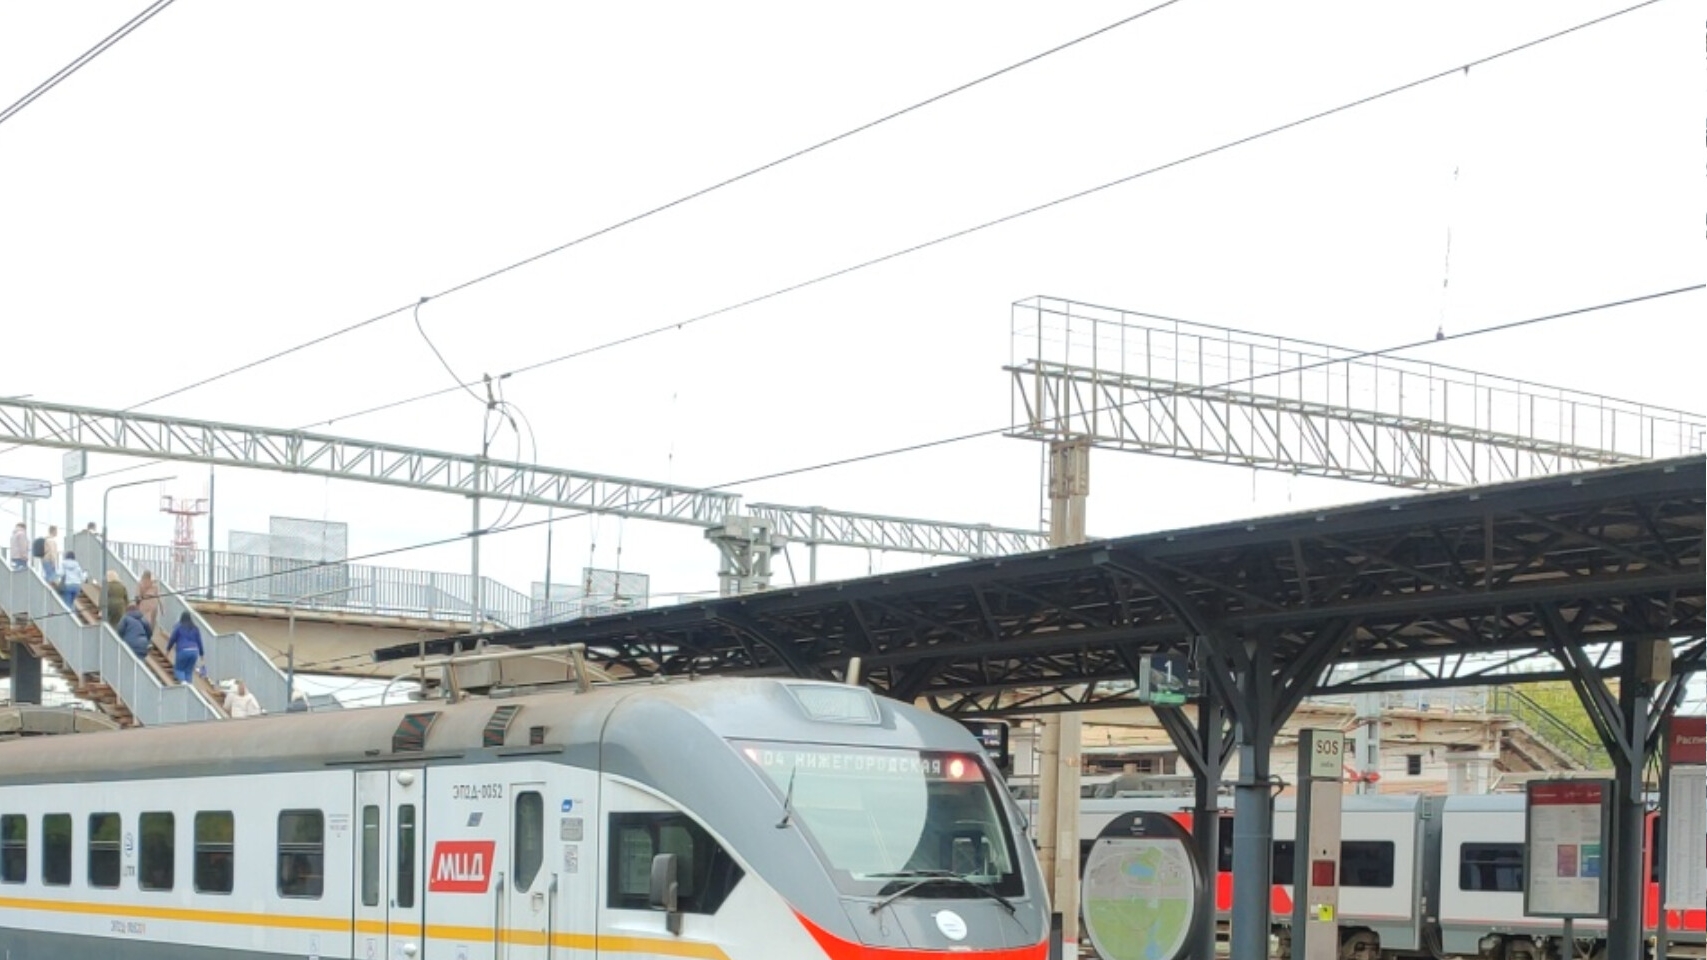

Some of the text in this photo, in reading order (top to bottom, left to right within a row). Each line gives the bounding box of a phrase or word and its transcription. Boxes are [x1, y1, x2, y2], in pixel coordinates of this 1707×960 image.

[1316, 739, 1339, 755] SOS
[795, 752, 941, 775] НИЖЕГОРОДСКАЯ
[436, 852, 485, 881] МЦД
